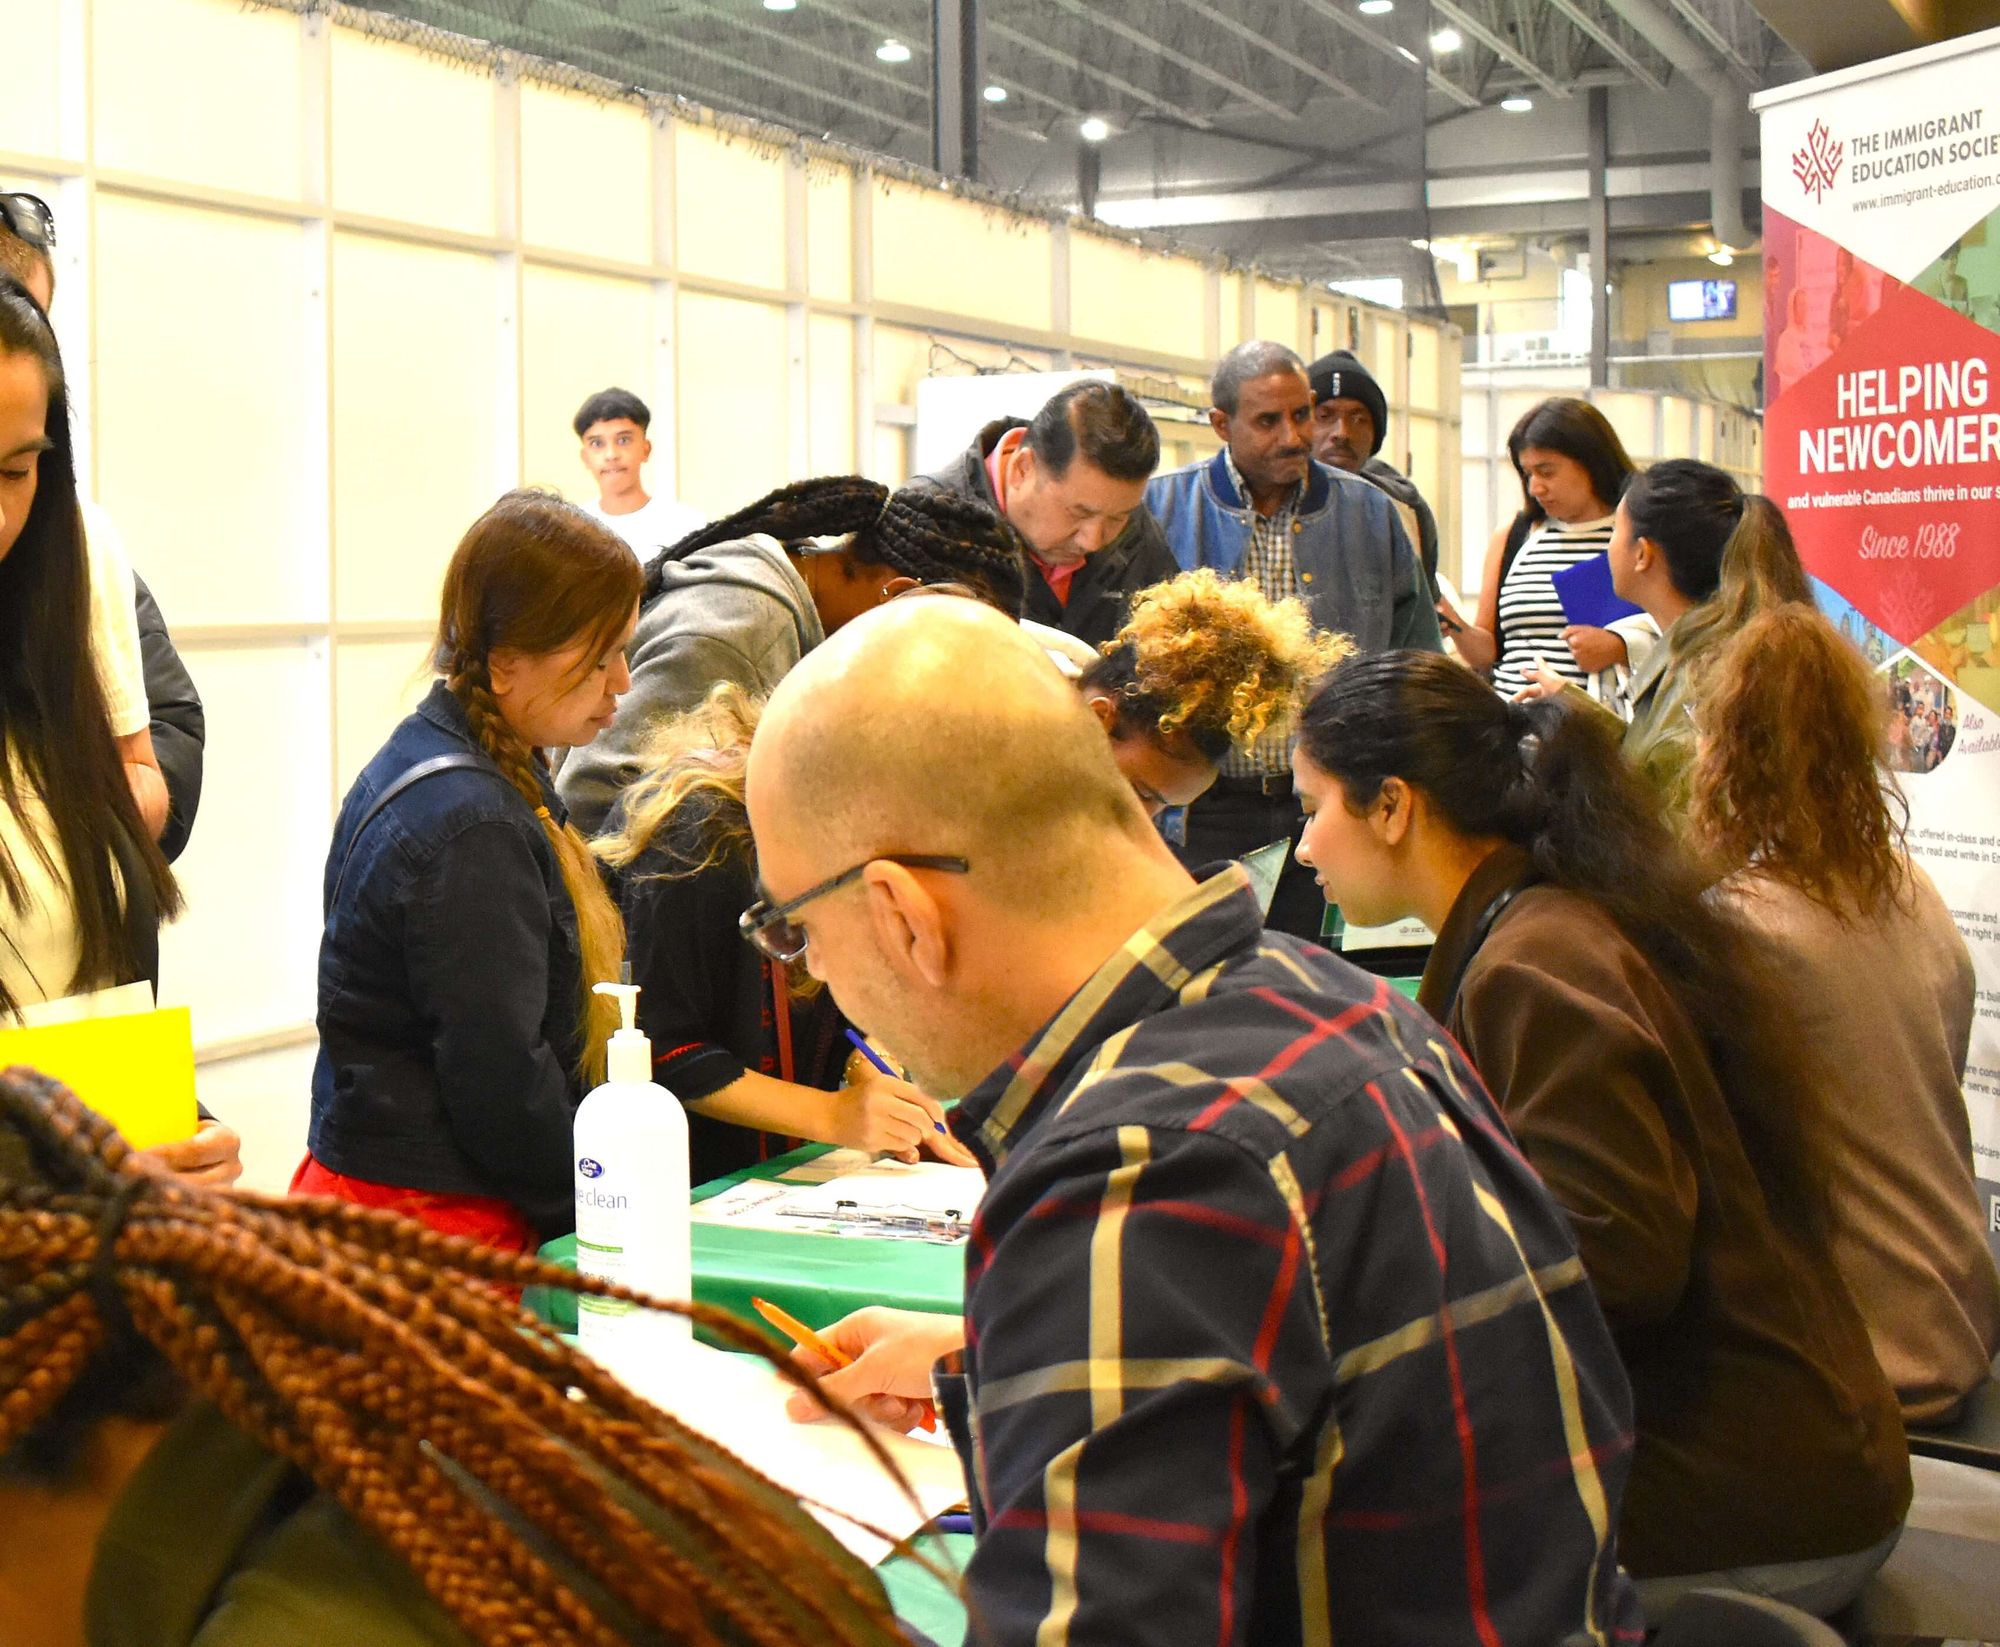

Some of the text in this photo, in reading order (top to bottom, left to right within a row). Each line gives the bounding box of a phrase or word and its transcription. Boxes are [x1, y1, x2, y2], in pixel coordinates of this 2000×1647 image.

[1851, 109, 1983, 157] THE IMMIGRANT
[1852, 133, 2000, 184] EDUCATION SOCIE
[1837, 357, 1989, 420] HELPING
[1799, 412, 2000, 475] NEWCOMER
[1787, 492, 1810, 510] and
[1811, 489, 1863, 508] vulnerable
[1862, 486, 1921, 505] Canadians
[1923, 484, 1955, 503] thrive
[1957, 484, 1969, 500] in
[1970, 486, 1993, 500] our
[1858, 522, 1962, 561] Since 1988
[586, 1186, 627, 1209] clean
